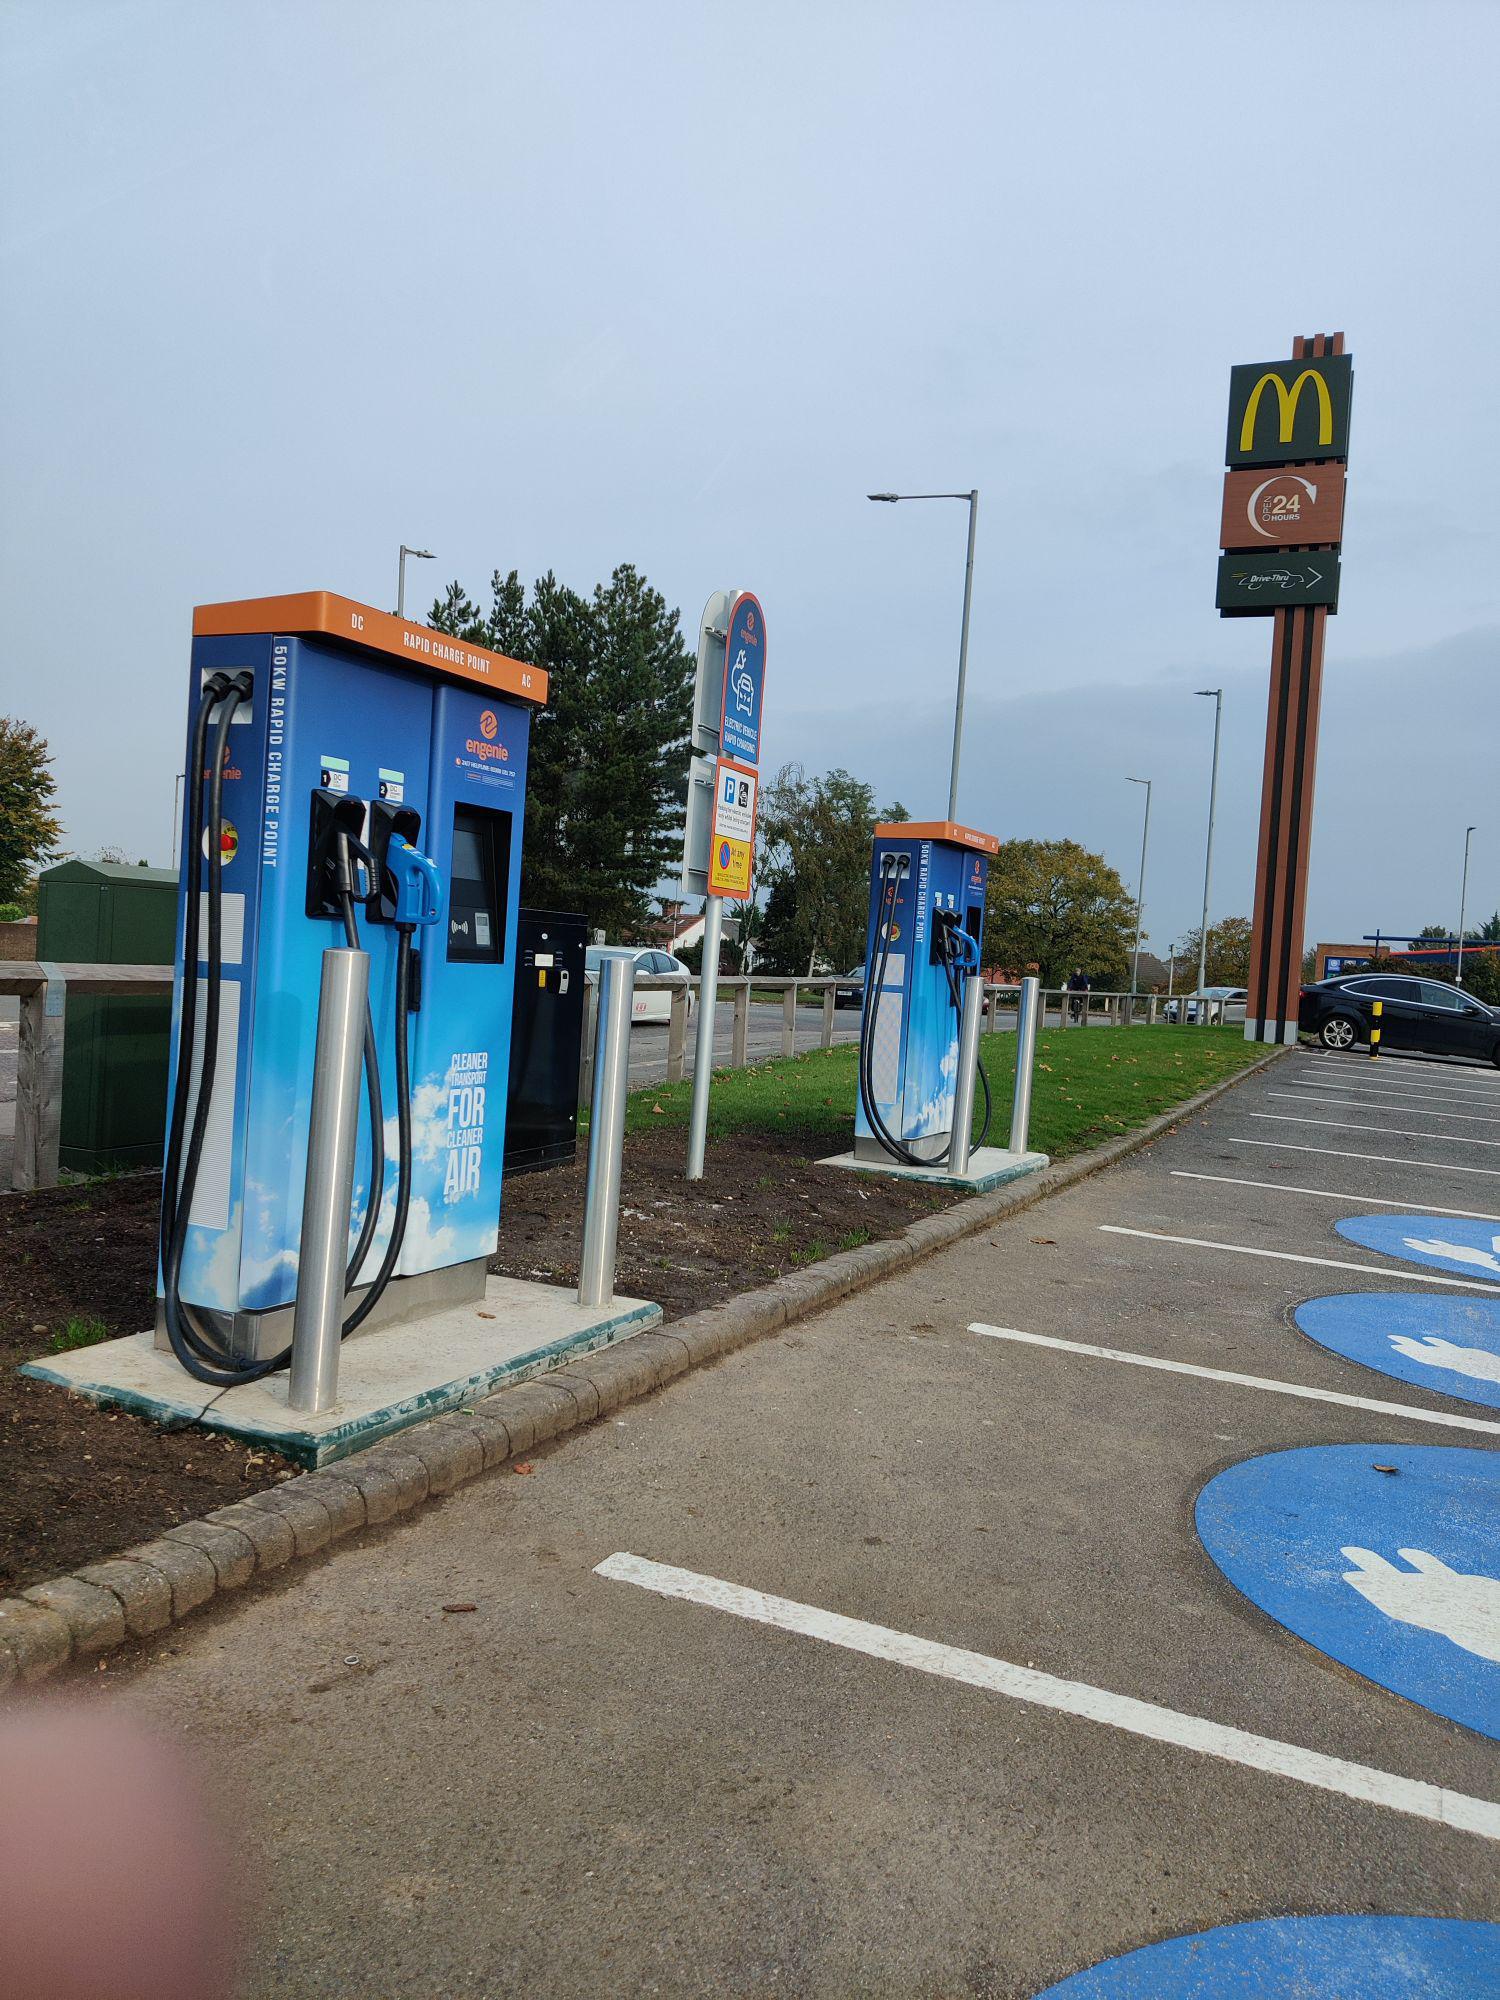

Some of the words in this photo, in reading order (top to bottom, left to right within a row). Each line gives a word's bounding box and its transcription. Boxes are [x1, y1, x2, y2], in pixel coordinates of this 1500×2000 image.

[1262, 495, 1272, 522] OPEN
[1271, 494, 1301, 514] 24
[1271, 513, 1300, 522] HOURS
[1250, 573, 1290, 583] Drive-Thru
[351, 613, 364, 631] DC
[403, 631, 430, 654] RAPID
[432, 641, 465, 666] CHARGE
[467, 654, 491, 674] POINT
[272, 645, 288, 691] 50KW
[521, 673, 532, 689] AC
[269, 697, 285, 746] RAPID
[724, 715, 743, 733] ELECTRIC
[465, 739, 509, 761] engenie
[265, 751, 282, 814] CHARGE
[322, 774, 327, 783] 1
[380, 785, 386, 794] 2
[262, 820, 280, 868] POINT
[918, 867, 928, 889] RAPID
[915, 922, 924, 943] POINT
[451, 1051, 488, 1070] CLEANER
[449, 1070, 487, 1087] TRANSPORT
[447, 1086, 486, 1130] FOR
[446, 1127, 483, 1149] CLEANER
[443, 1145, 483, 1195] AIR
